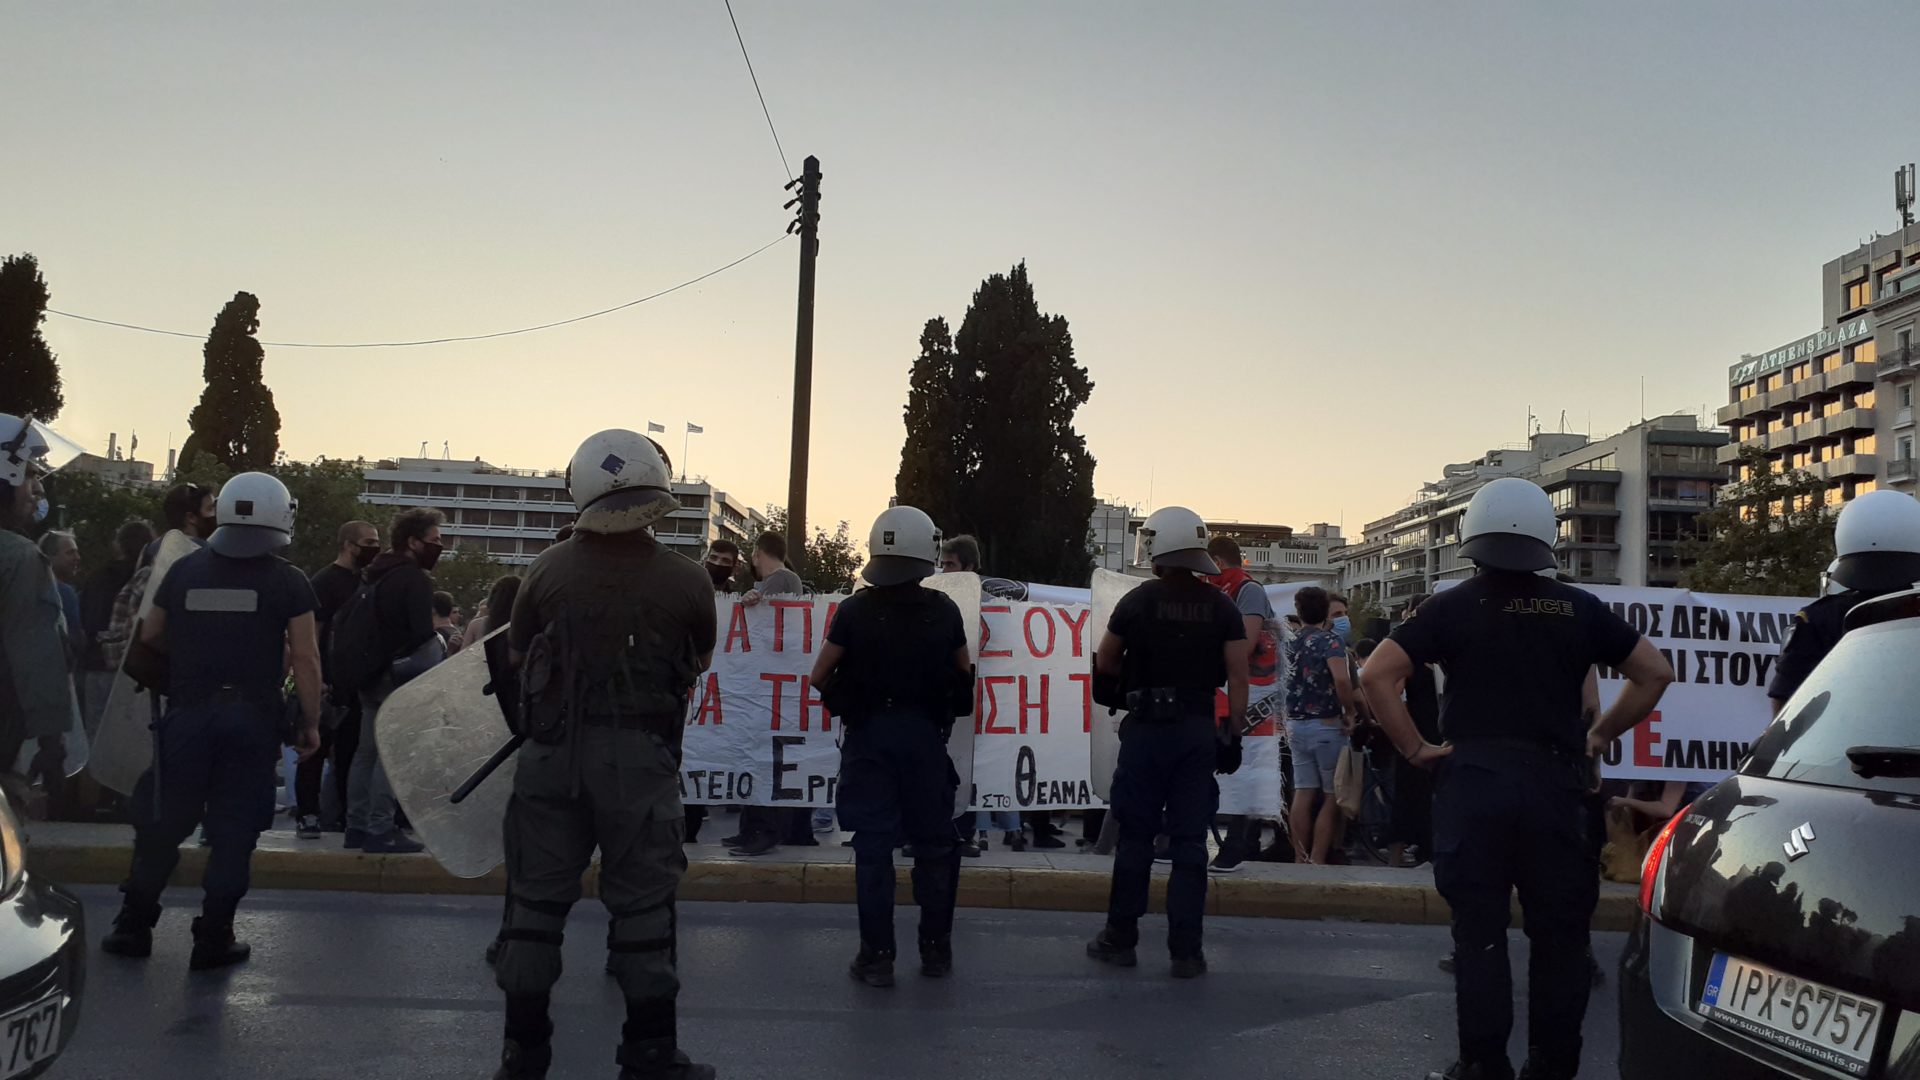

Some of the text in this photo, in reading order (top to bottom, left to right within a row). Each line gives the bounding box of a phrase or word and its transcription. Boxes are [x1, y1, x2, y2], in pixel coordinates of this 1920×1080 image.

[1760, 338, 1814, 372] ATHENS
[1817, 319, 1868, 350] PLAZA
[1157, 601, 1214, 622] POLICE
[1670, 605, 1730, 641] ΔΕΝ
[1695, 650, 1780, 687] ΣΤΟΥ
[1706, 984, 1719, 998] GR
[1714, 1010, 1865, 1073] www.suzuki-sfakianakis.gr
